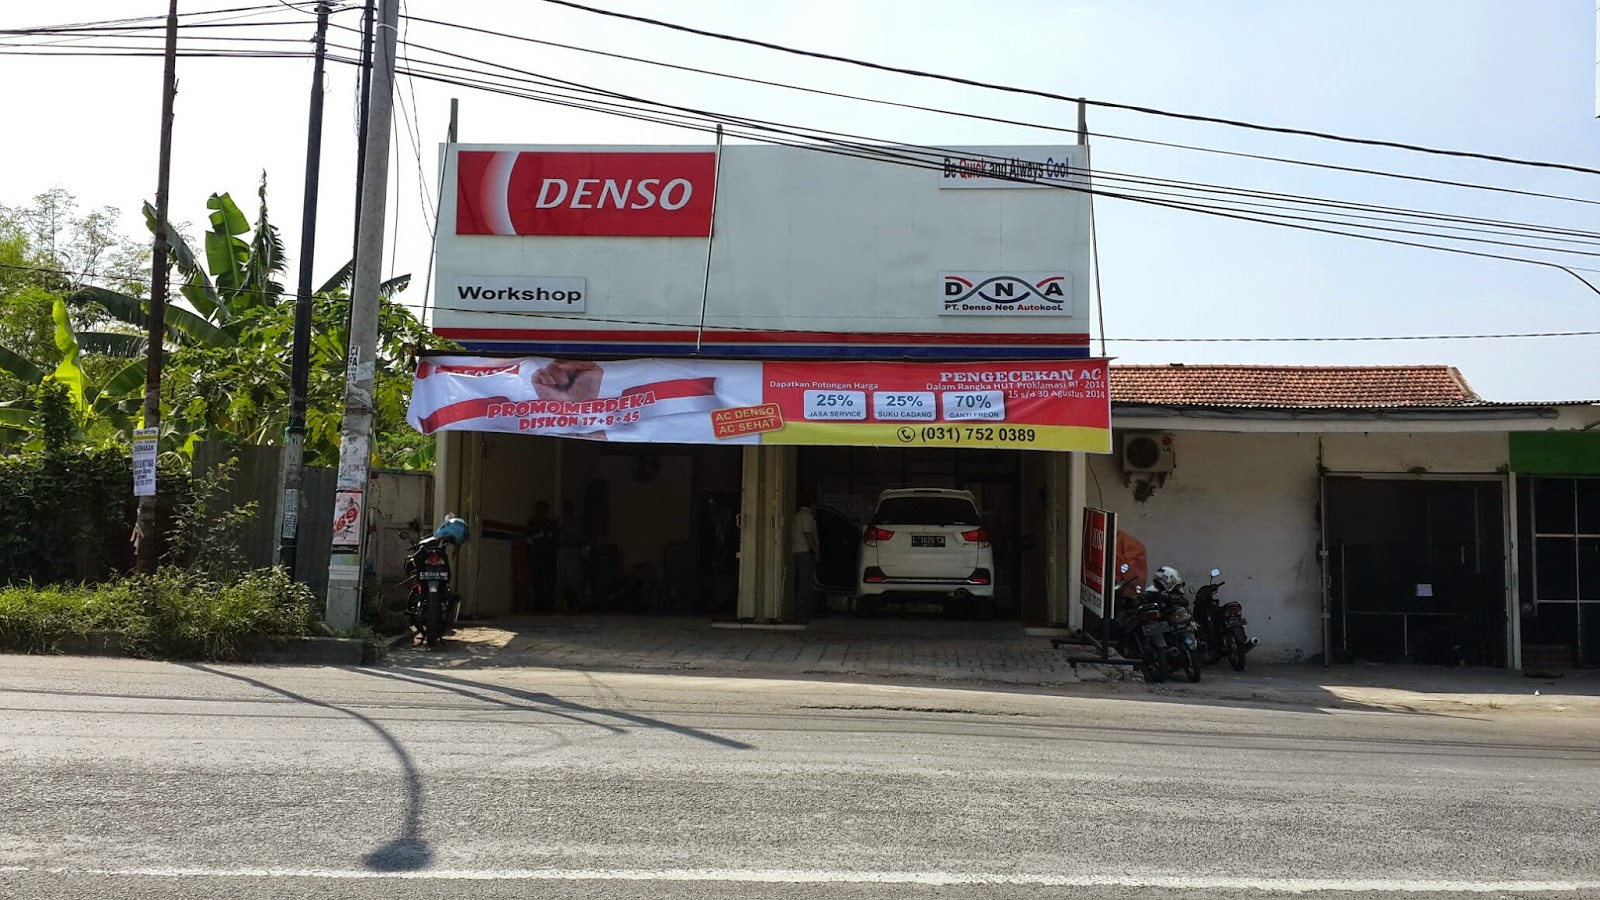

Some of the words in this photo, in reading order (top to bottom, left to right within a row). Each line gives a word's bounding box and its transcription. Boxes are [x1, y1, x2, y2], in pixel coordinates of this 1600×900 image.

[943, 158, 957, 178] Be
[959, 157, 986, 179] Quick
[989, 158, 1007, 177] and
[1009, 157, 1044, 181] Always
[1047, 157, 1069, 178] Cool
[535, 178, 693, 211] DENSO
[457, 286, 582, 304] Workshop
[940, 370, 1075, 382] PENGECEKAN
[1079, 368, 1102, 380] AC
[812, 381, 852, 389] Potongan
[854, 382, 879, 390] Harga
[958, 383, 991, 391] Rangka
[1017, 381, 1066, 389] Proklamasi
[1085, 380, 1105, 388] 2014
[816, 394, 854, 407] 25%
[886, 395, 923, 407] 25%
[954, 395, 991, 408] 70%
[1008, 390, 1019, 398] 15
[1021, 390, 1036, 399] s/d
[1038, 390, 1048, 398] 30
[1050, 390, 1084, 399] Agustus
[1085, 390, 1105, 399] 2014
[487, 401, 562, 419] PROMO
[563, 391, 657, 415] MERDEKA
[518, 416, 578, 431] DISKON
[582, 411, 641, 426] 17+8+45
[716, 411, 733, 422] AC
[735, 407, 775, 419] DENSO
[719, 425, 736, 435] AC
[738, 418, 776, 432] SEHAT
[921, 427, 961, 443] (031)
[965, 427, 994, 441] 752
[998, 428, 1036, 442] 0389
